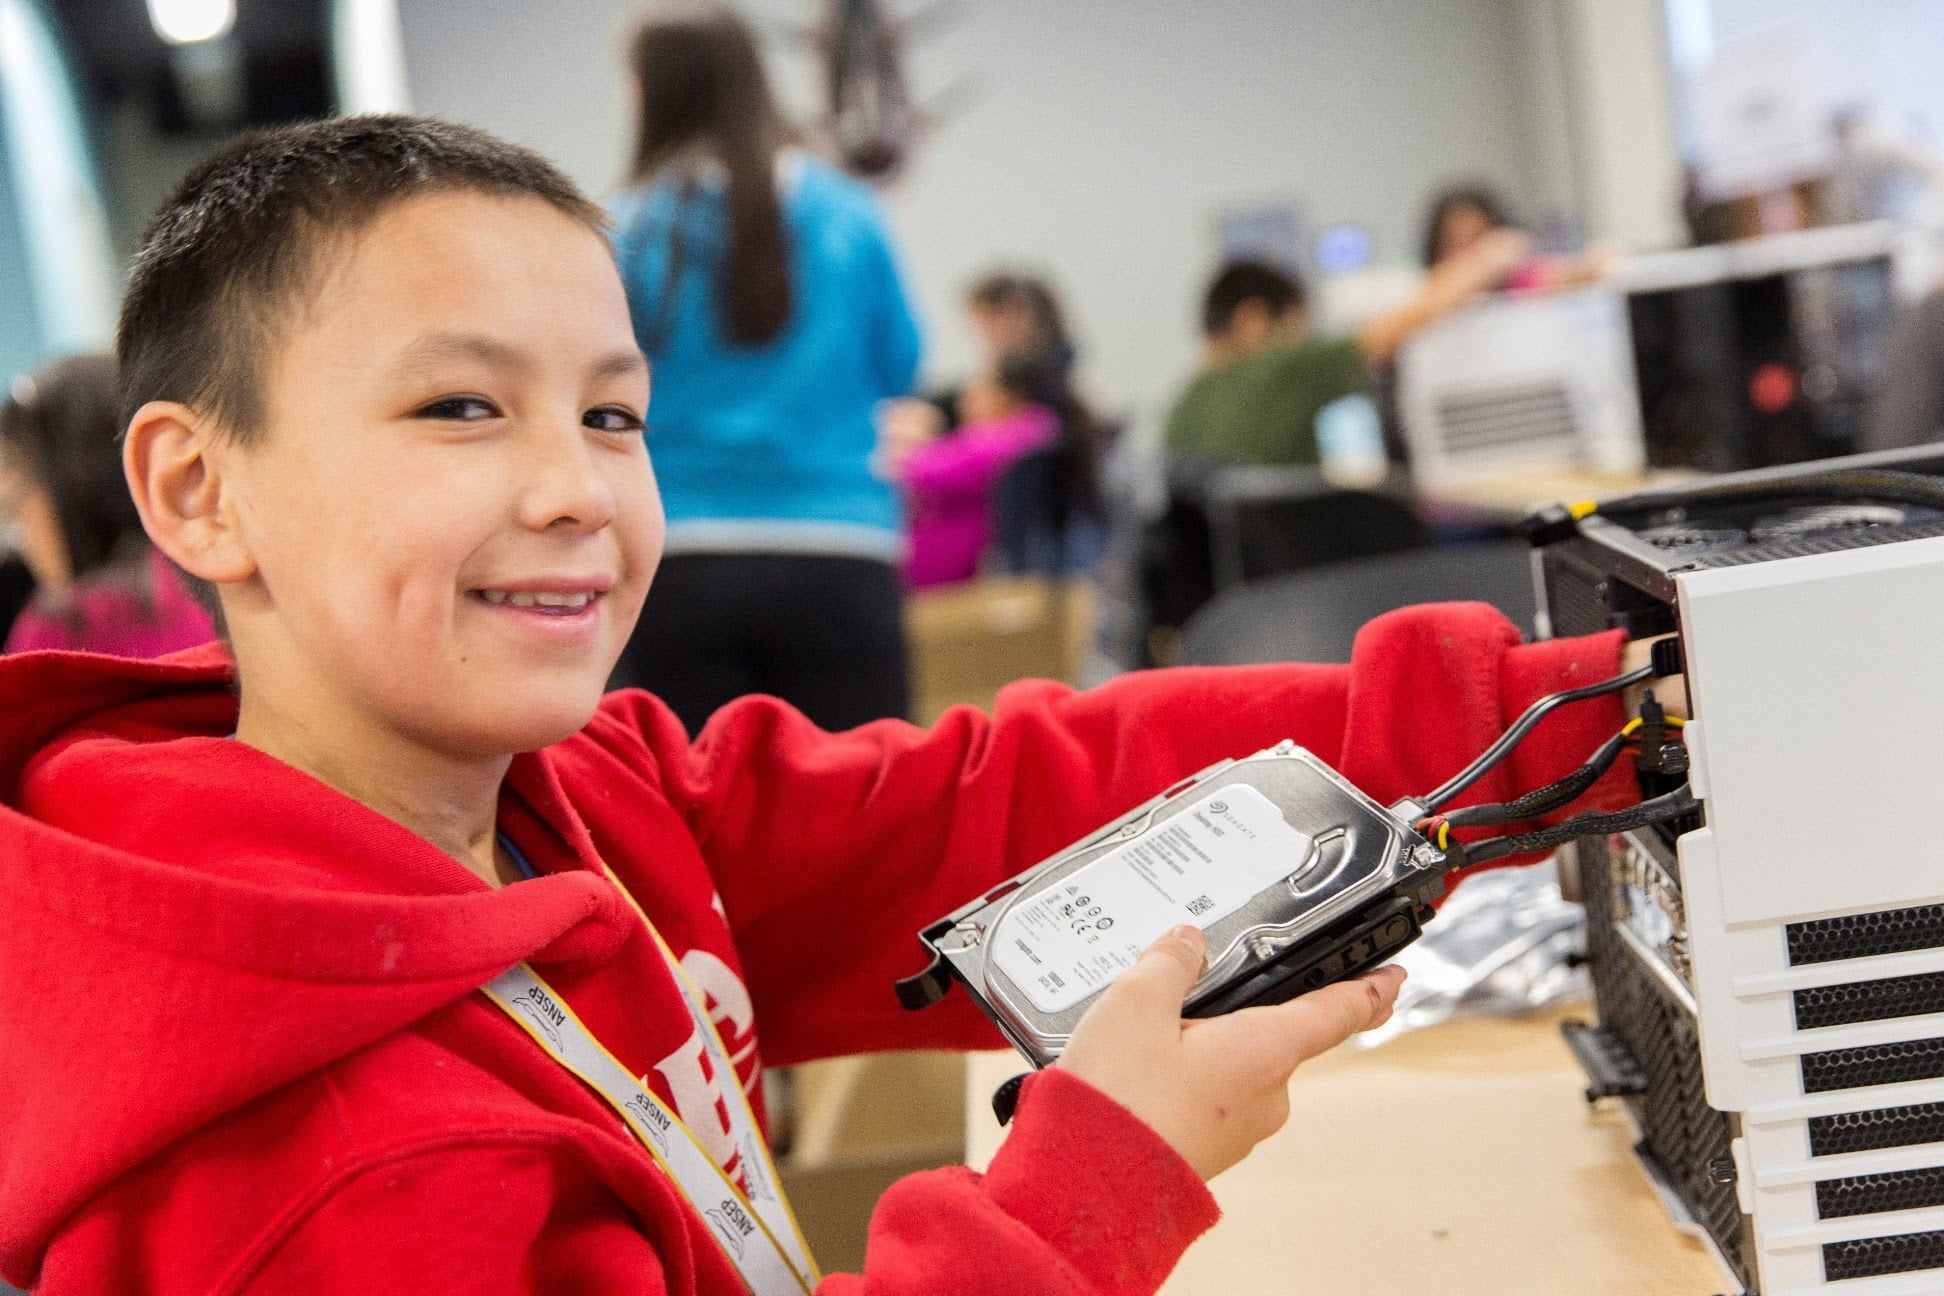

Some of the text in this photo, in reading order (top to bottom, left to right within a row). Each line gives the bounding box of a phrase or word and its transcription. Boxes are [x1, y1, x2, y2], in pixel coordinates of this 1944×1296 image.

[1223, 812, 1257, 840] SEAGATE
[528, 986, 566, 1027] ANSEP
[635, 1092, 672, 1131] ANSEP
[721, 1198, 756, 1237] ANSEP
